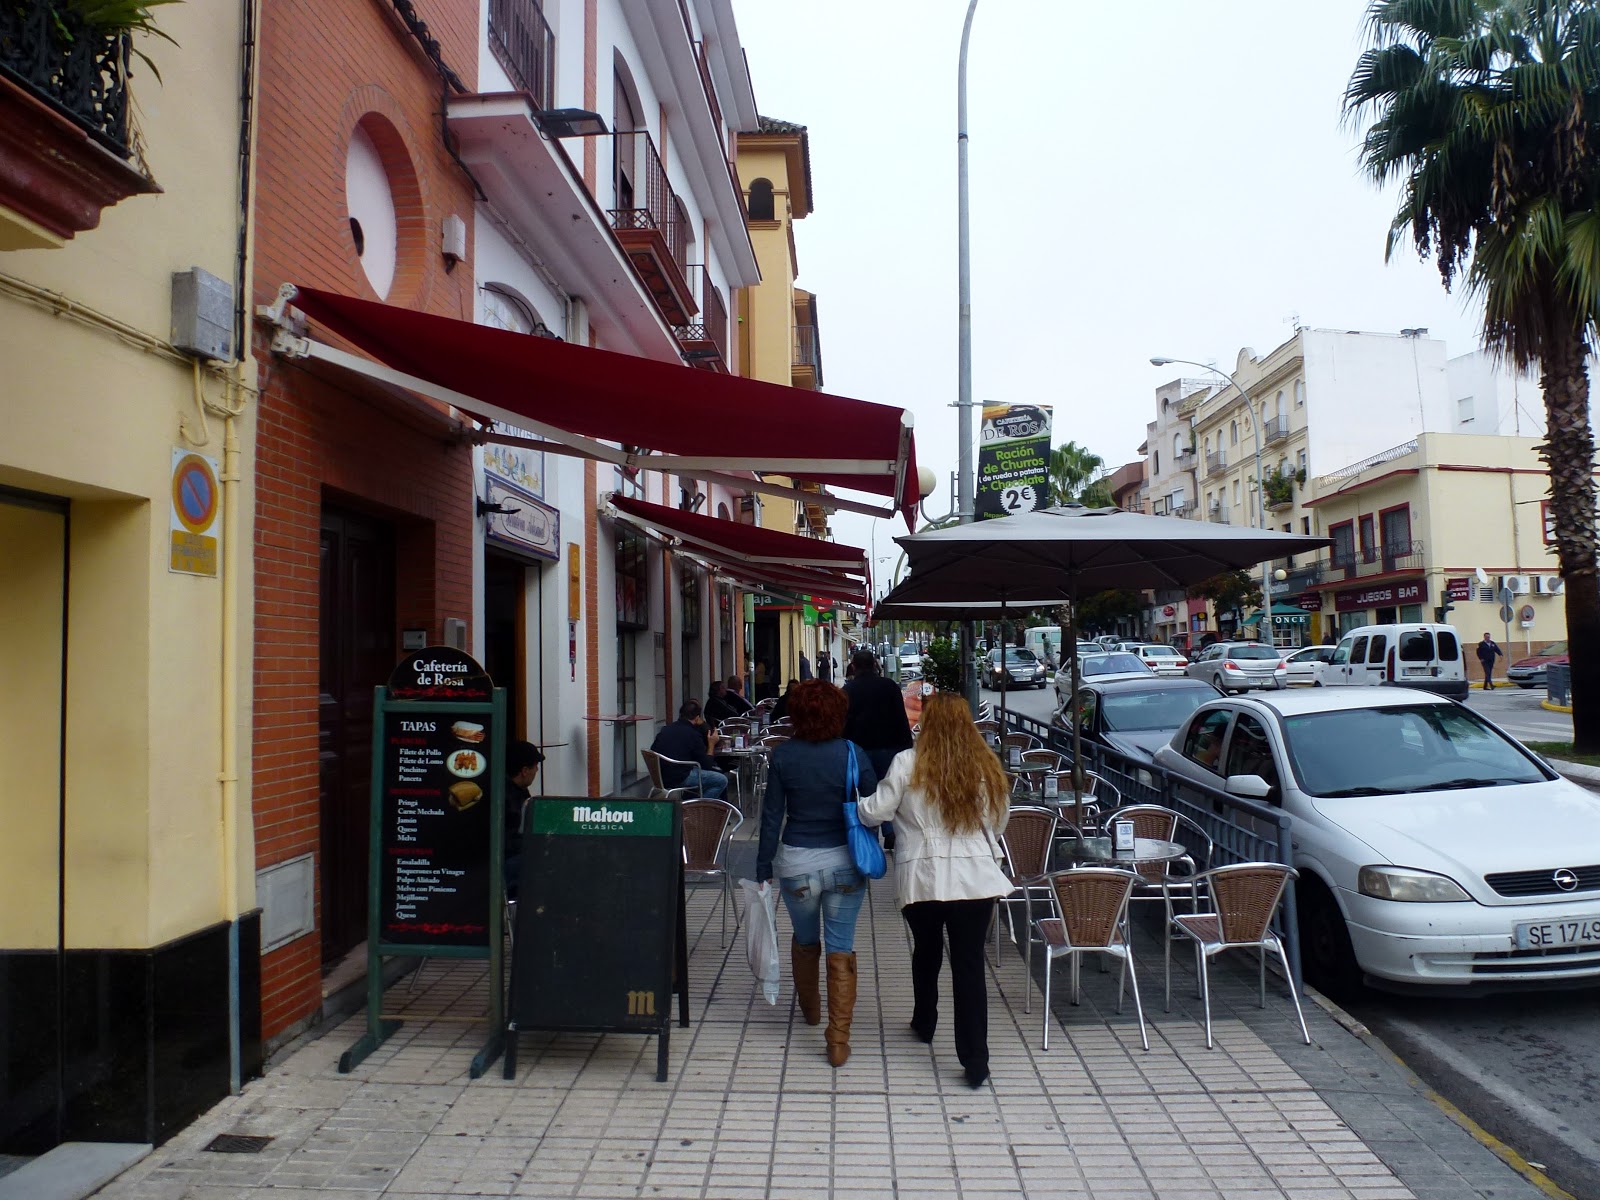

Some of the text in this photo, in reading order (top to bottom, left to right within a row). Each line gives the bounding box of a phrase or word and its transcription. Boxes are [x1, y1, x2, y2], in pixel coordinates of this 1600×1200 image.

[984, 419, 1050, 440] DE ROSA
[995, 446, 1035, 460] Ración
[983, 457, 1045, 475] de Churros
[982, 474, 992, 482] de
[992, 471, 1012, 481] rueda
[1020, 467, 1045, 477] patatas
[990, 475, 1045, 491] Chocolate
[1006, 487, 1032, 510] 2€
[754, 595, 772, 606] aja
[1357, 589, 1392, 603] JUEGOS
[1398, 586, 1419, 598] BAR
[1275, 616, 1306, 624] ONCE
[413, 659, 468, 672] Cafetería
[417, 673, 464, 686] de Rosa
[400, 721, 437, 731] TAPAS
[417, 808, 445, 816] Mechada
[573, 806, 634, 823] Mahou
[397, 834, 417, 842] Melva
[397, 858, 430, 866] Ensaladilla
[396, 867, 432, 876] Boquerones
[441, 868, 465, 876] Vinagre
[396, 876, 415, 884] Pulpo
[396, 893, 428, 902] Mejillones
[396, 911, 416, 919] Queso
[1529, 921, 1600, 944] SE 1749
